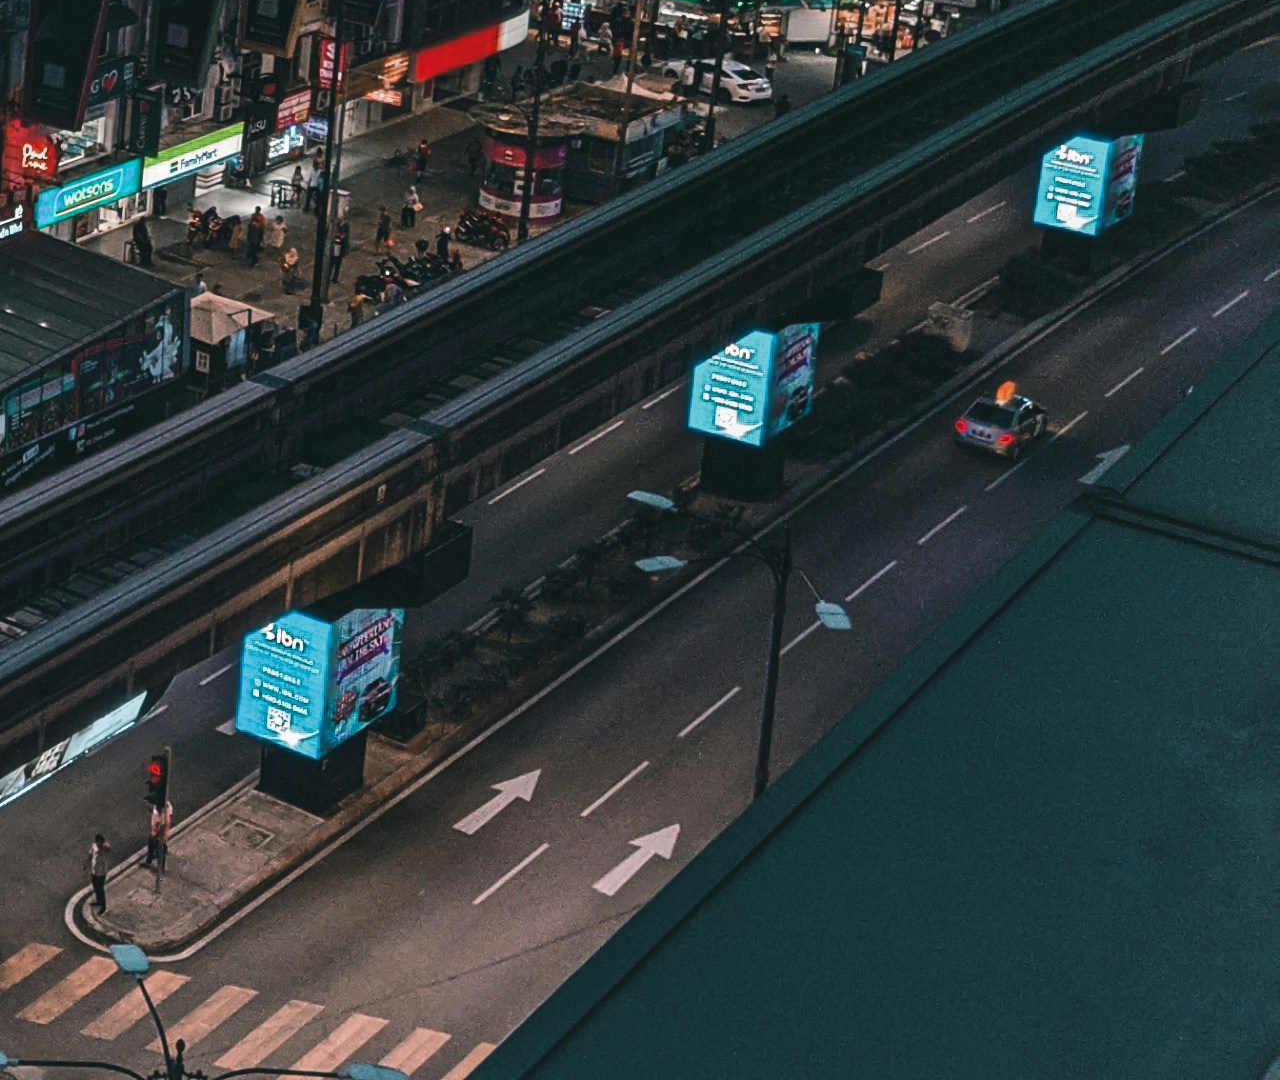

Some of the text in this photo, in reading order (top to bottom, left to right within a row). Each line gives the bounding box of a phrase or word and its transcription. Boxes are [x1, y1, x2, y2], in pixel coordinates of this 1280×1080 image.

[180, 148, 218, 170] FamilyMart
[63, 179, 115, 206] watsons
[276, 628, 305, 653] ibn
